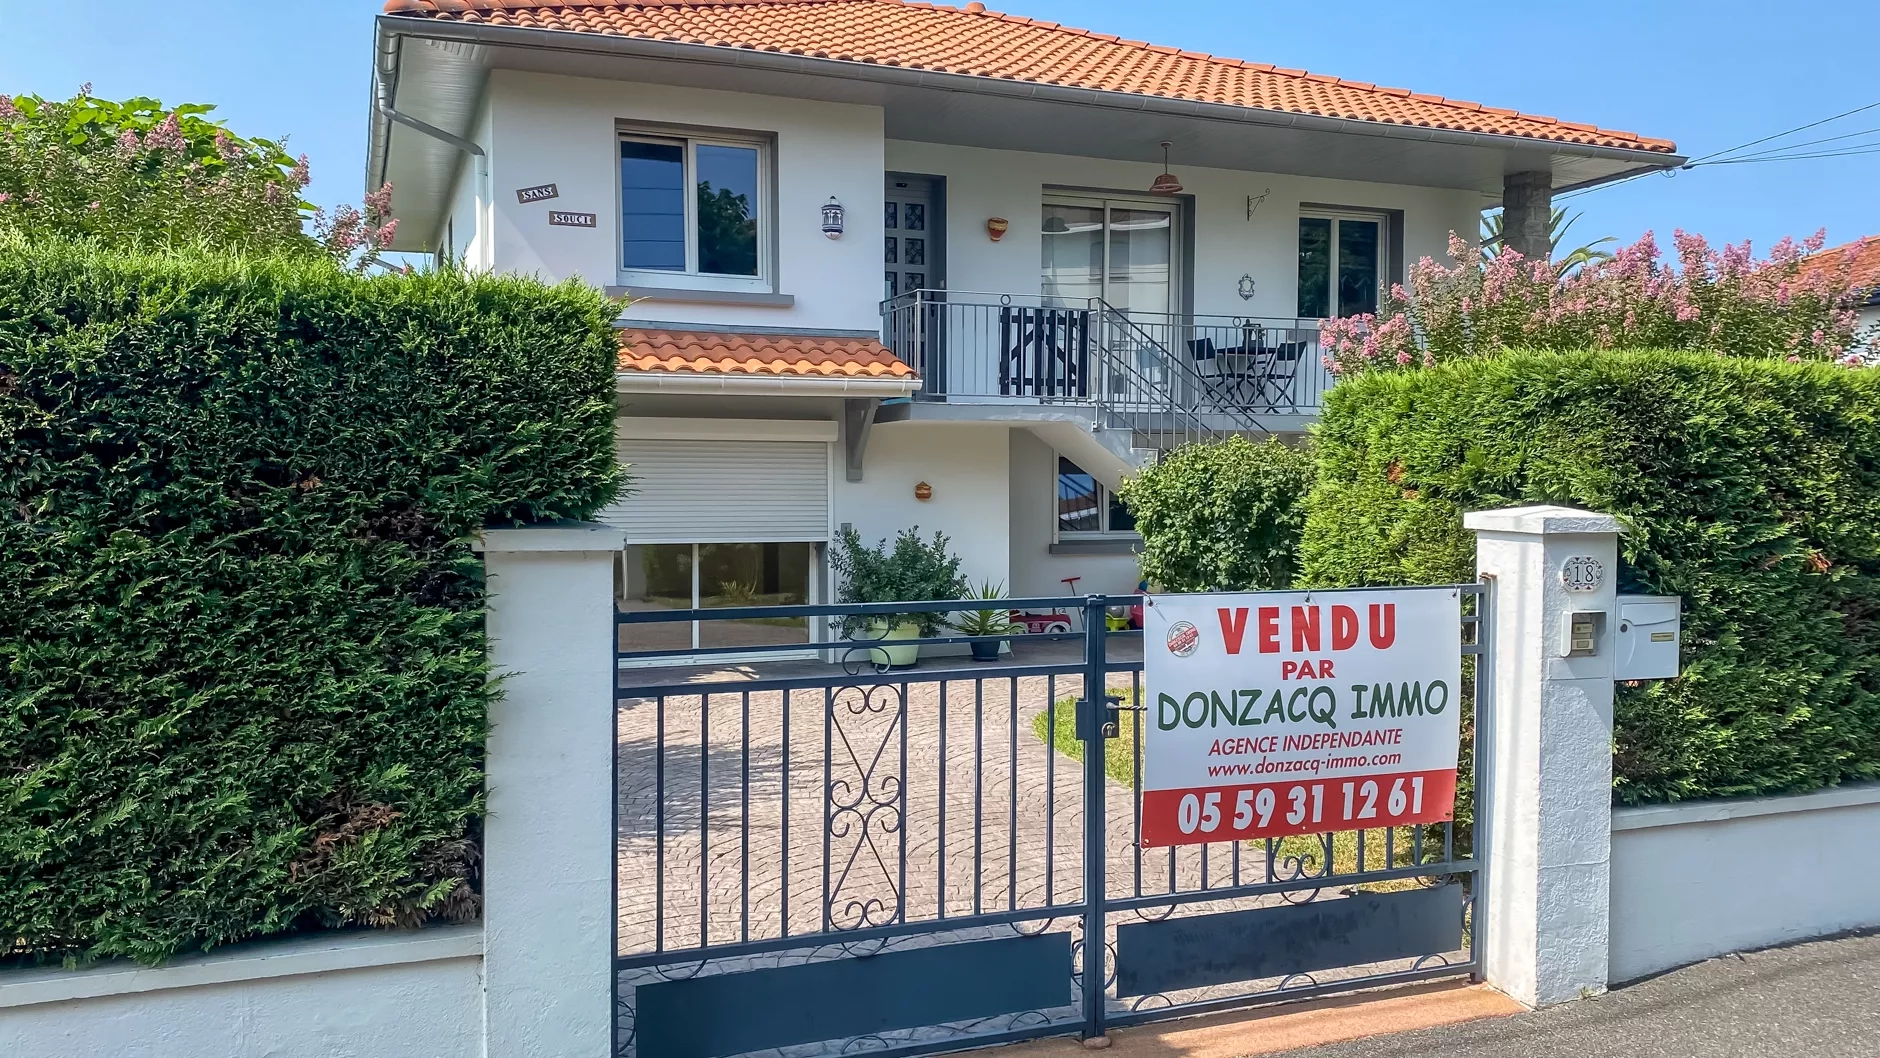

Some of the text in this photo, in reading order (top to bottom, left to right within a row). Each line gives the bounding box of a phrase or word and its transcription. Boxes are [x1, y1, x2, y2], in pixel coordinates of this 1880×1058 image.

[521, 186, 554, 200] SANS
[553, 213, 592, 225] SOUCI
[1573, 564, 1595, 583] 18
[1217, 603, 1396, 655] VENDU
[1282, 659, 1336, 681] PAR
[1157, 679, 1449, 731] DONZACQ IMMO
[1208, 728, 1403, 757] AGENCE INDEPENDANTE
[1208, 752, 1402, 778] www.donzacq-immo.com
[1177, 776, 1425, 835] 05 59 31 12 61
